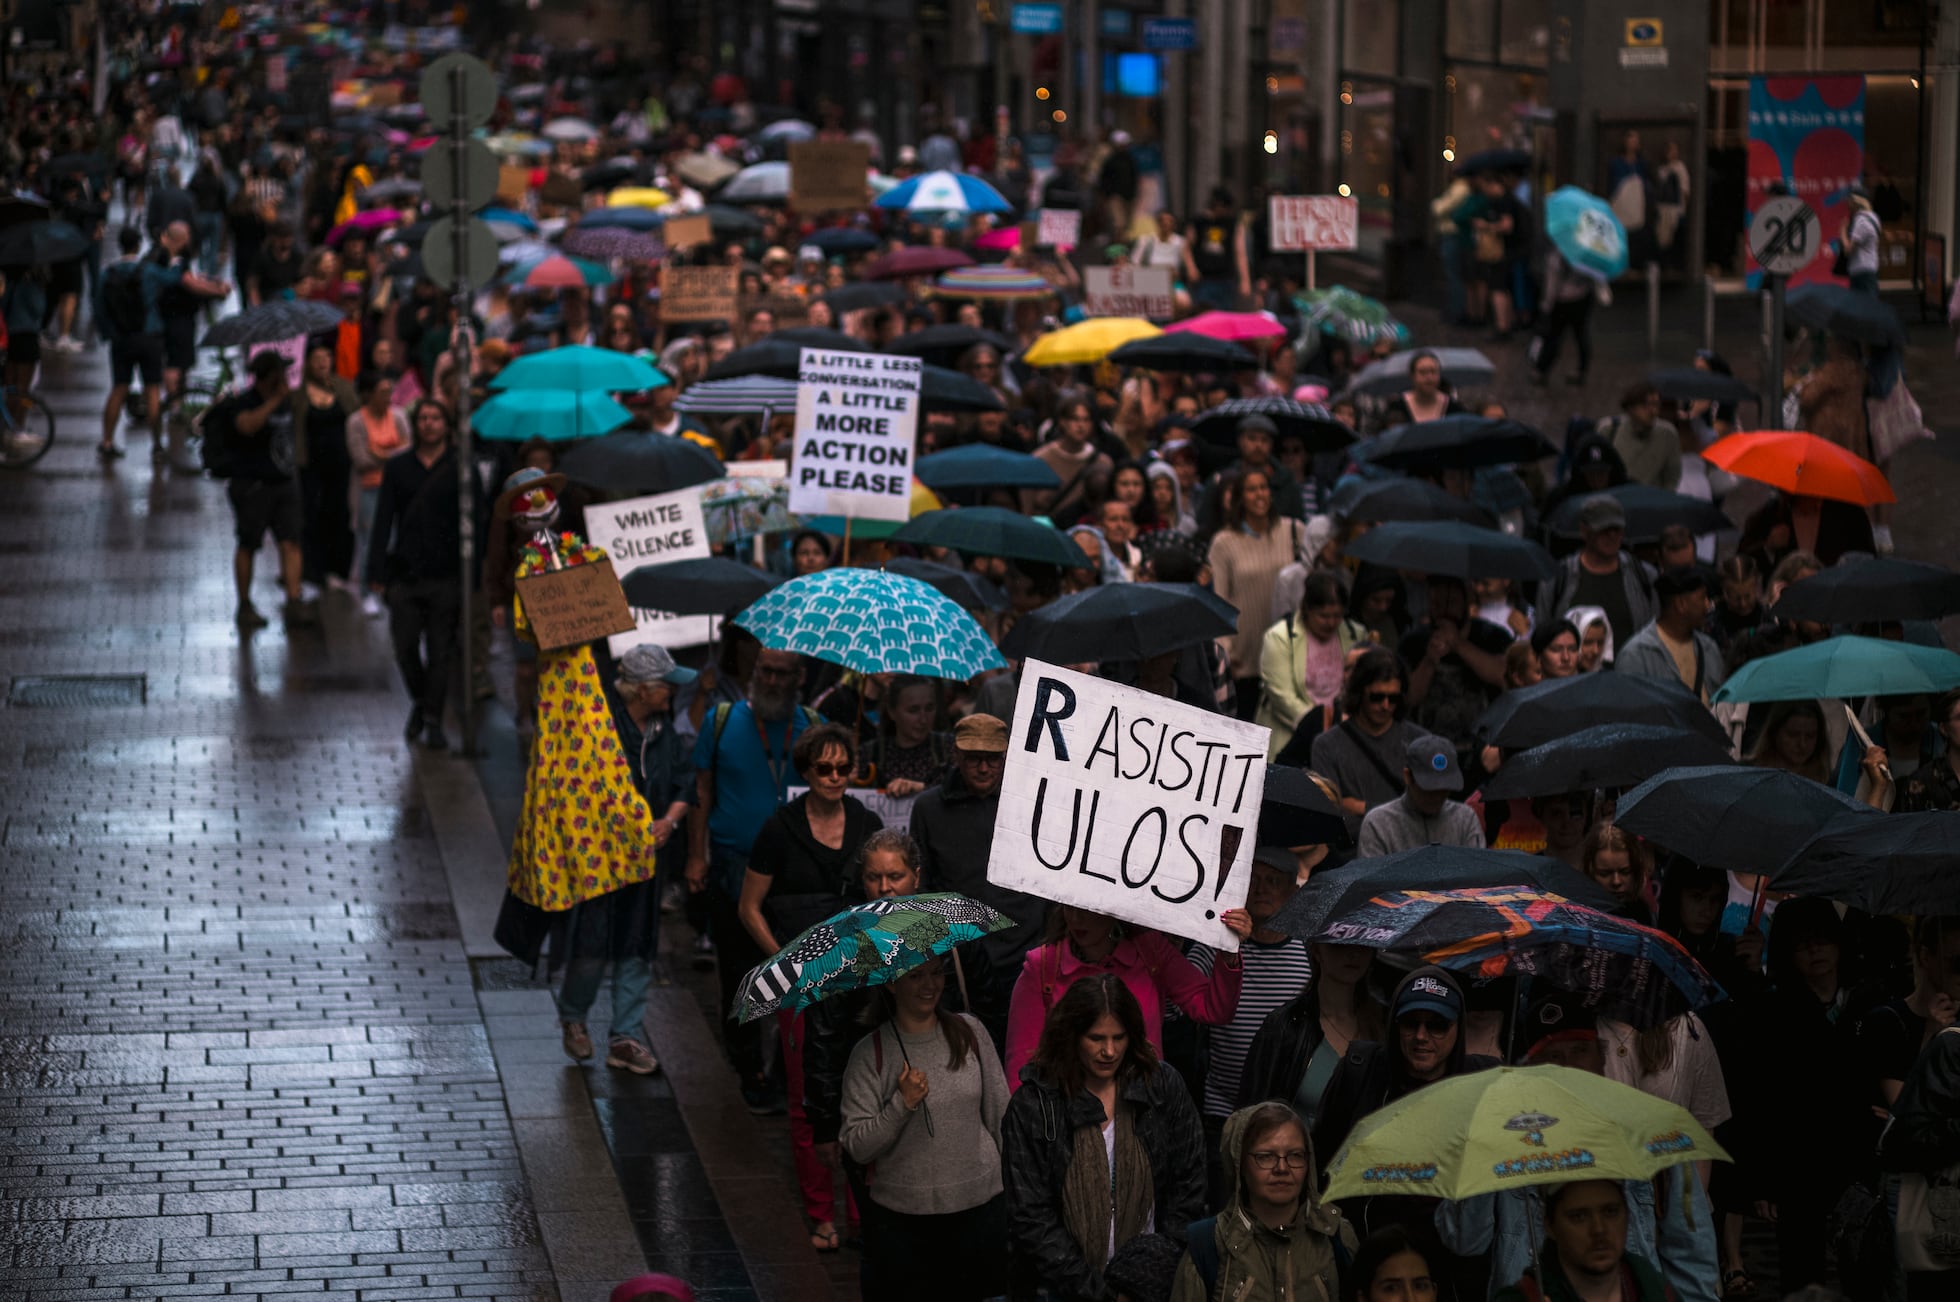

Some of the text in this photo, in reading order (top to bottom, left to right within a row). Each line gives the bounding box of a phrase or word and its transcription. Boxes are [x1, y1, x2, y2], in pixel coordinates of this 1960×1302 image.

[1765, 217, 1807, 253] 20
[806, 354, 921, 372] A LITTLE LESS
[799, 372, 921, 393] CONVERSATION,
[817, 391, 907, 411] A LITTLE
[816, 414, 888, 435] MORE
[802, 439, 907, 466] ACTION
[800, 468, 904, 495] PLEASE
[614, 504, 682, 530] WHITE
[612, 529, 694, 560] SILENCE
[1031, 777, 1244, 920] ULOS!
[1326, 922, 1397, 942] NEW YORK
